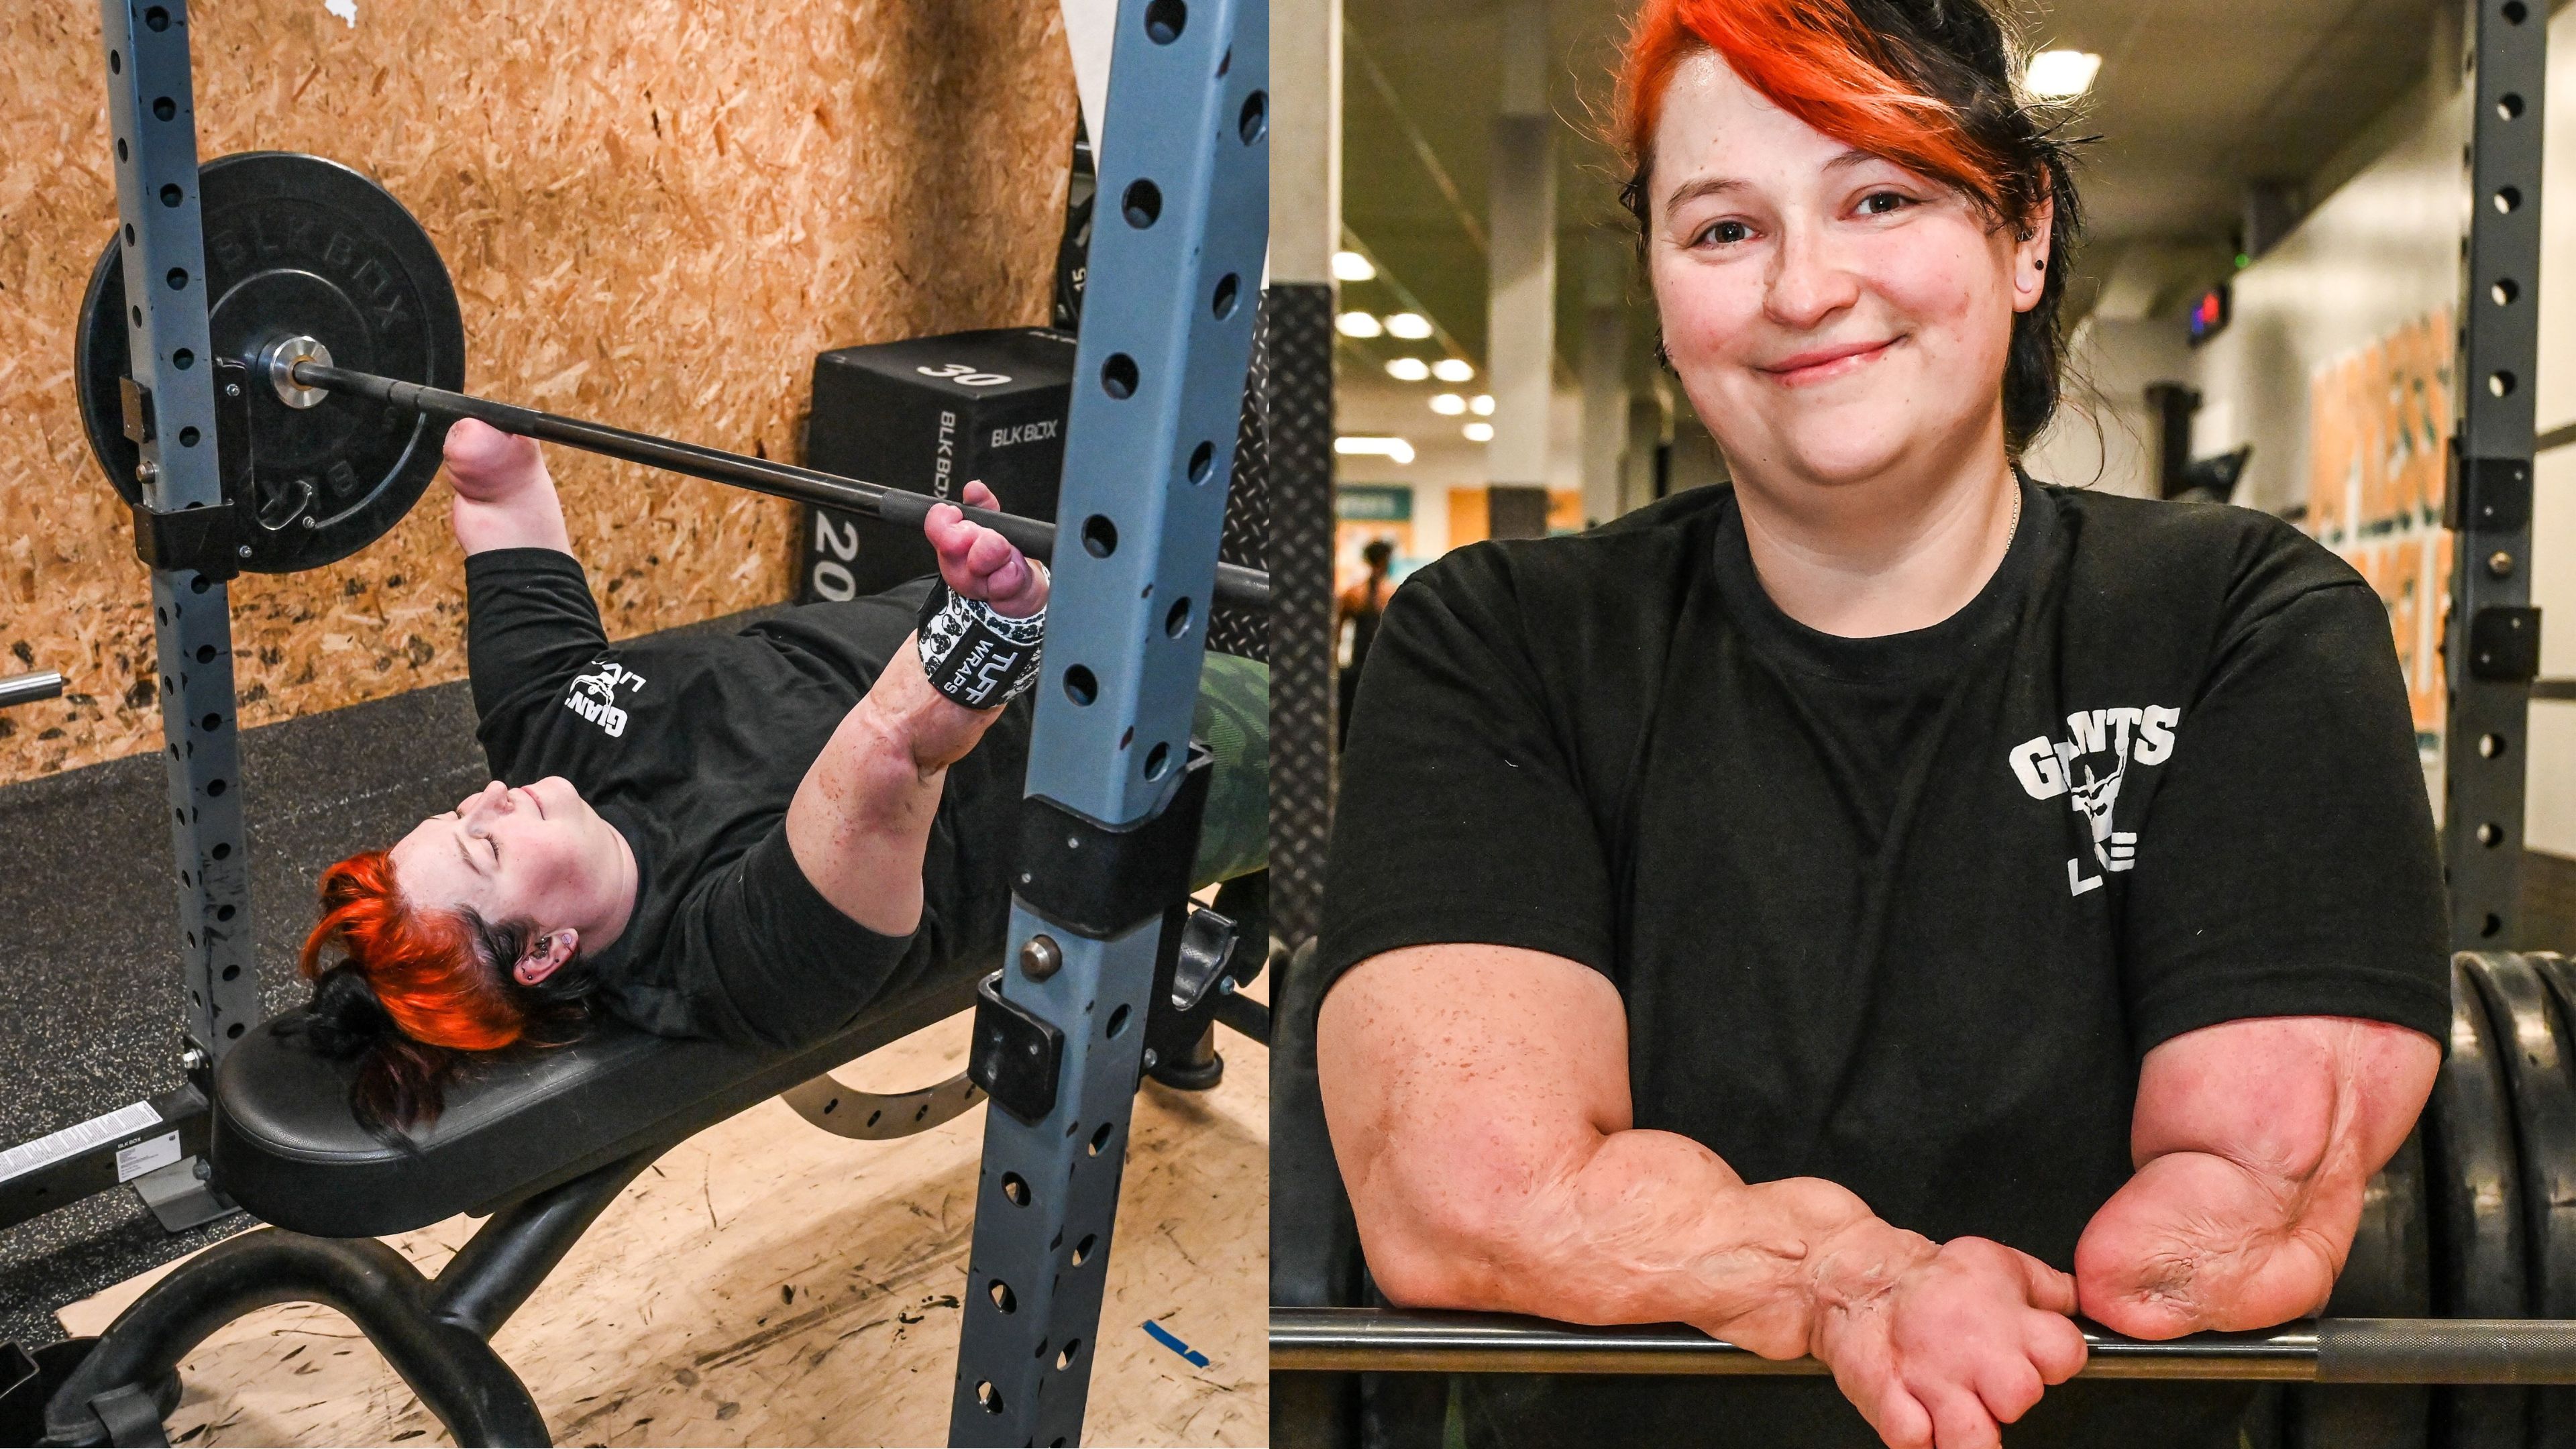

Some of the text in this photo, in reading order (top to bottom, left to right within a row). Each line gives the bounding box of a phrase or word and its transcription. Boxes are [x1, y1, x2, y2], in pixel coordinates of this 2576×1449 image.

[323, 229, 409, 333] BOX
[1072, 267, 1087, 291] 15
[916, 363, 1013, 386] 30
[938, 411, 956, 456] BLK
[991, 419, 1059, 448] BLK BOX
[813, 510, 859, 602] 20
[943, 639, 994, 694] WRAPS
[965, 651, 1019, 704] TUFF
[564, 691, 629, 738] GIAN
[2008, 704, 2181, 800] GINTS
[2067, 832, 2137, 897] LE
